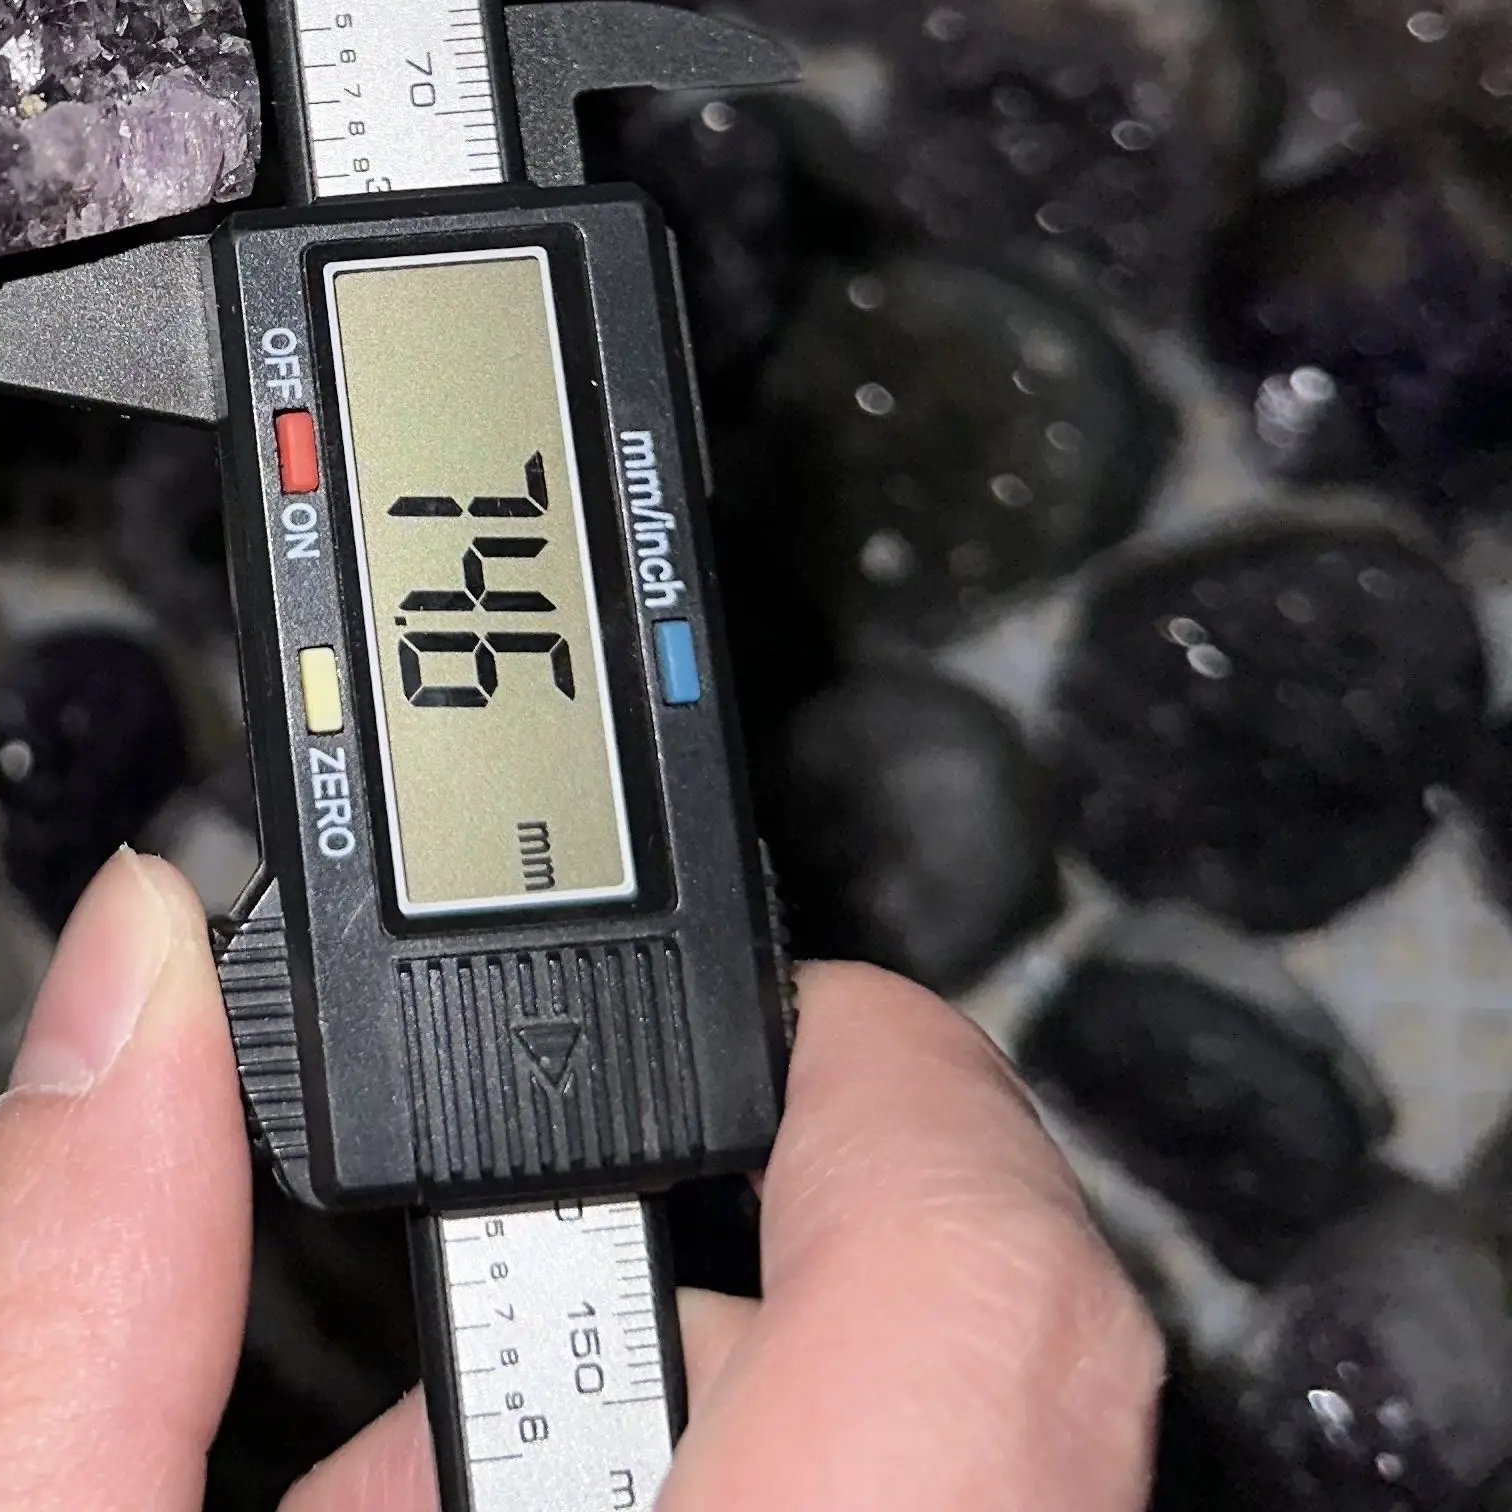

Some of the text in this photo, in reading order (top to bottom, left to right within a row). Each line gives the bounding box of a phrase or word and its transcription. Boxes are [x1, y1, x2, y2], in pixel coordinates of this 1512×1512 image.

[335, 13, 353, 30] 5
[340, 49, 357, 65] 6
[405, 51, 437, 109] 70
[344, 83, 362, 100] 7
[348, 120, 366, 137] 8
[352, 157, 370, 174] 9
[260, 326, 303, 399] OFF
[619, 429, 687, 609] mm/inch
[284, 501, 321, 561] ON
[387, 450, 576, 891] 74.6 mm
[308, 746, 356, 859] ZERO
[485, 1219, 505, 1238] 5
[494, 1303, 515, 1322] 7
[500, 1347, 520, 1366] 8
[567, 1300, 605, 1396] 150
[505, 1391, 525, 1411] 9
